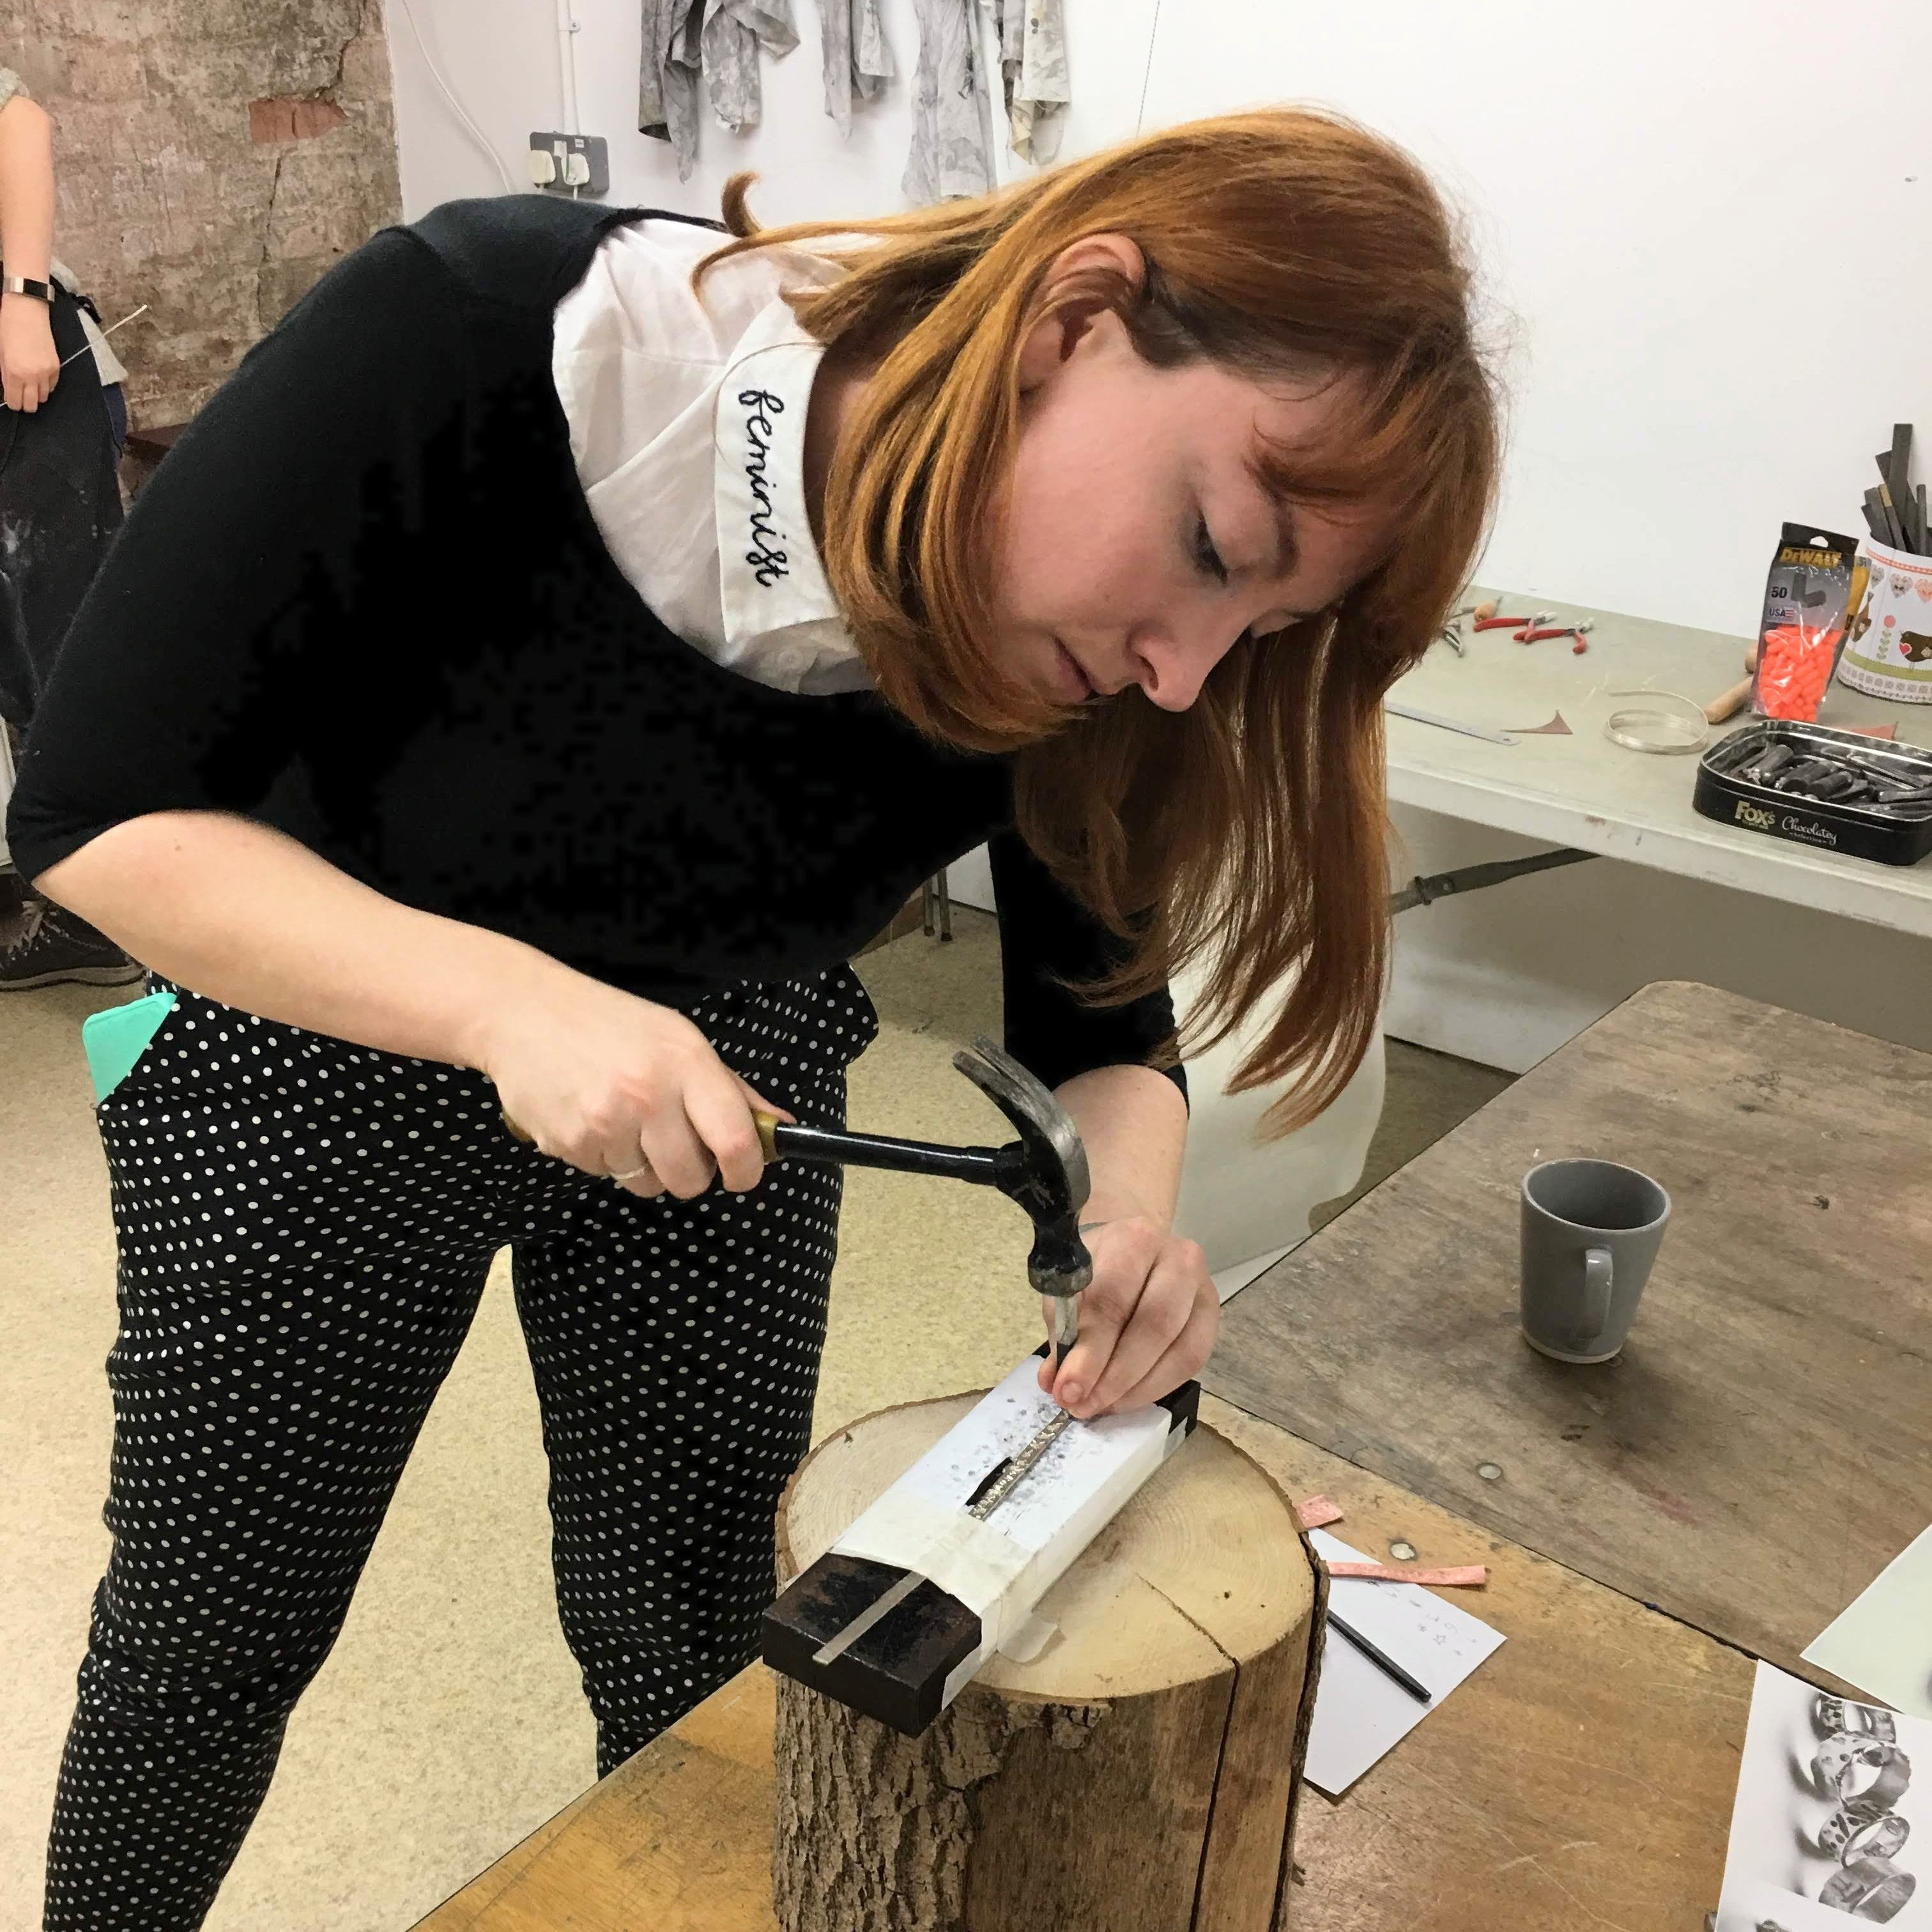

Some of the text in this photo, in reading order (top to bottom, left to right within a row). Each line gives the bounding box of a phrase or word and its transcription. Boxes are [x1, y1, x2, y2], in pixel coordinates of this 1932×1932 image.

[739, 389, 789, 587] feminist
[1771, 586, 1788, 598] 50
[1769, 608, 1786, 617] USA
